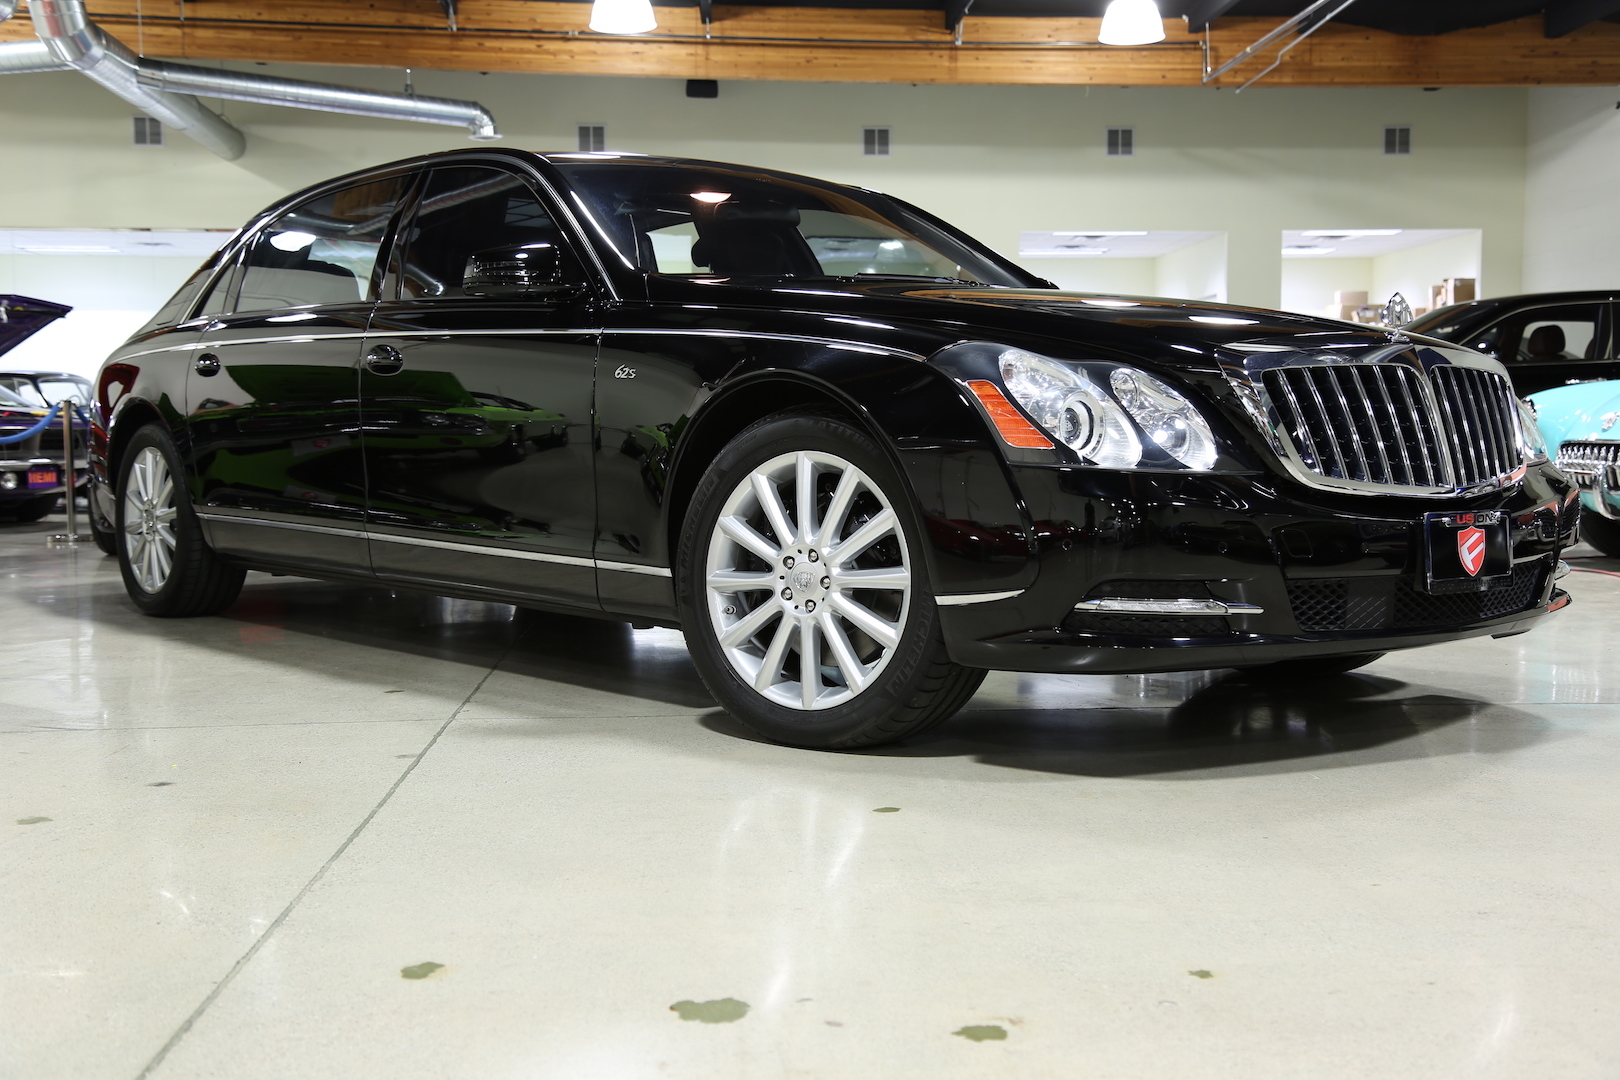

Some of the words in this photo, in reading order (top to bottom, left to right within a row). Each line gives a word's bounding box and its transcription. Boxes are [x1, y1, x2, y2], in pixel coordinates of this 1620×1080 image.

[808, 419, 882, 458] LATITUDE
[28, 472, 57, 483] HEMI
[890, 591, 933, 695] MICHELIN
